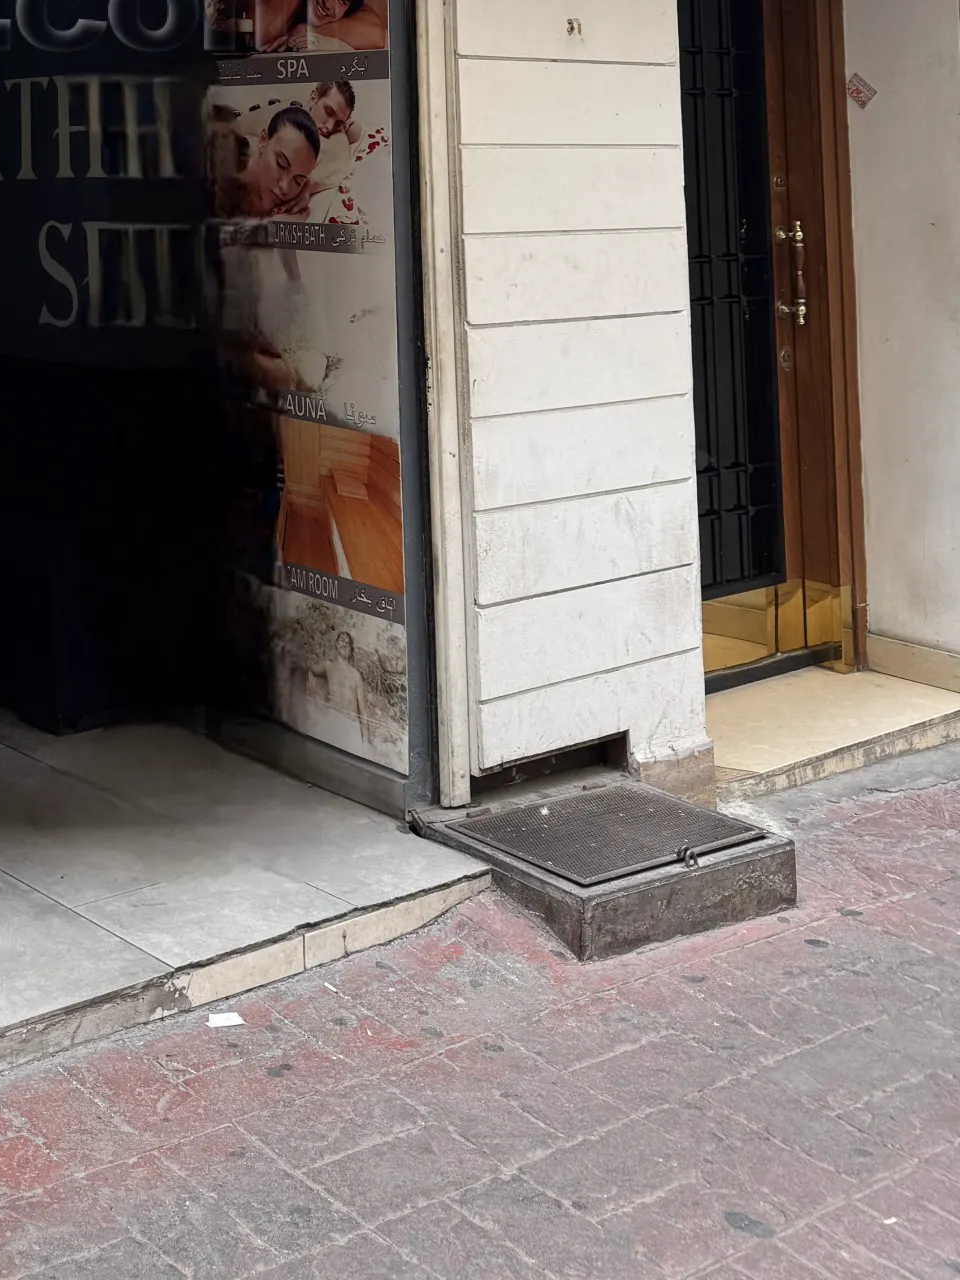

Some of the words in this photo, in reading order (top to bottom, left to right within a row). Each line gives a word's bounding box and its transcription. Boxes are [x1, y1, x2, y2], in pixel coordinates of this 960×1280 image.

[276, 58, 310, 79] SPA
[273, 223, 303, 245] URKISH
[305, 225, 327, 245] BATH
[285, 394, 328, 421] AUNA
[308, 572, 339, 600] ROOM
